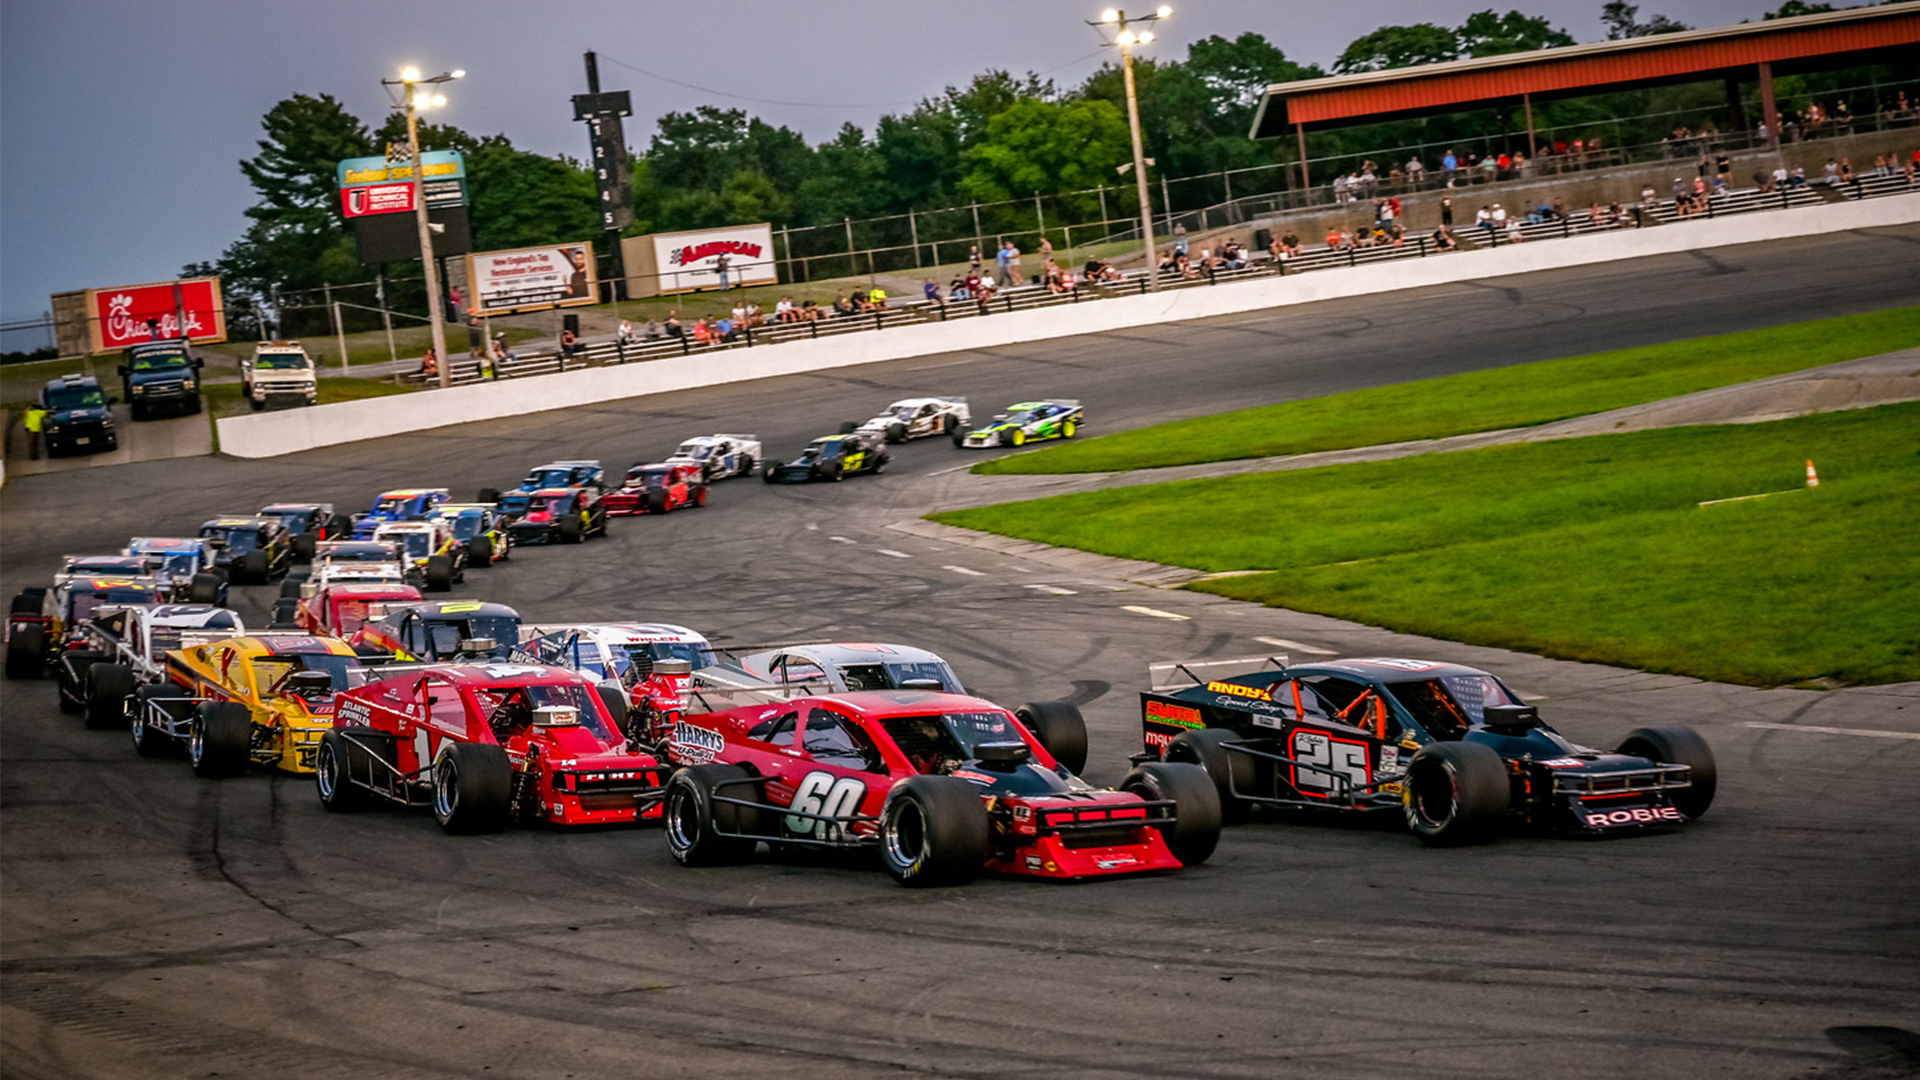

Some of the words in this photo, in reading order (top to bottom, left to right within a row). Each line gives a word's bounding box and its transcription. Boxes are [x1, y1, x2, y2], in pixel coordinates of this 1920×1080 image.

[593, 125, 601, 135] 1
[595, 146, 605, 158] 2
[598, 168, 607, 179] 3
[602, 190, 610, 201] 4
[604, 212, 613, 223] 5
[680, 241, 763, 266] AMERICAN
[342, 700, 371, 717] ATLANTIC
[1215, 695, 1252, 707] Speed
[1249, 701, 1281, 713] Shop
[337, 709, 371, 728] SPRINKLER
[785, 770, 866, 841] 60
[1585, 807, 1680, 826] ROBIE
